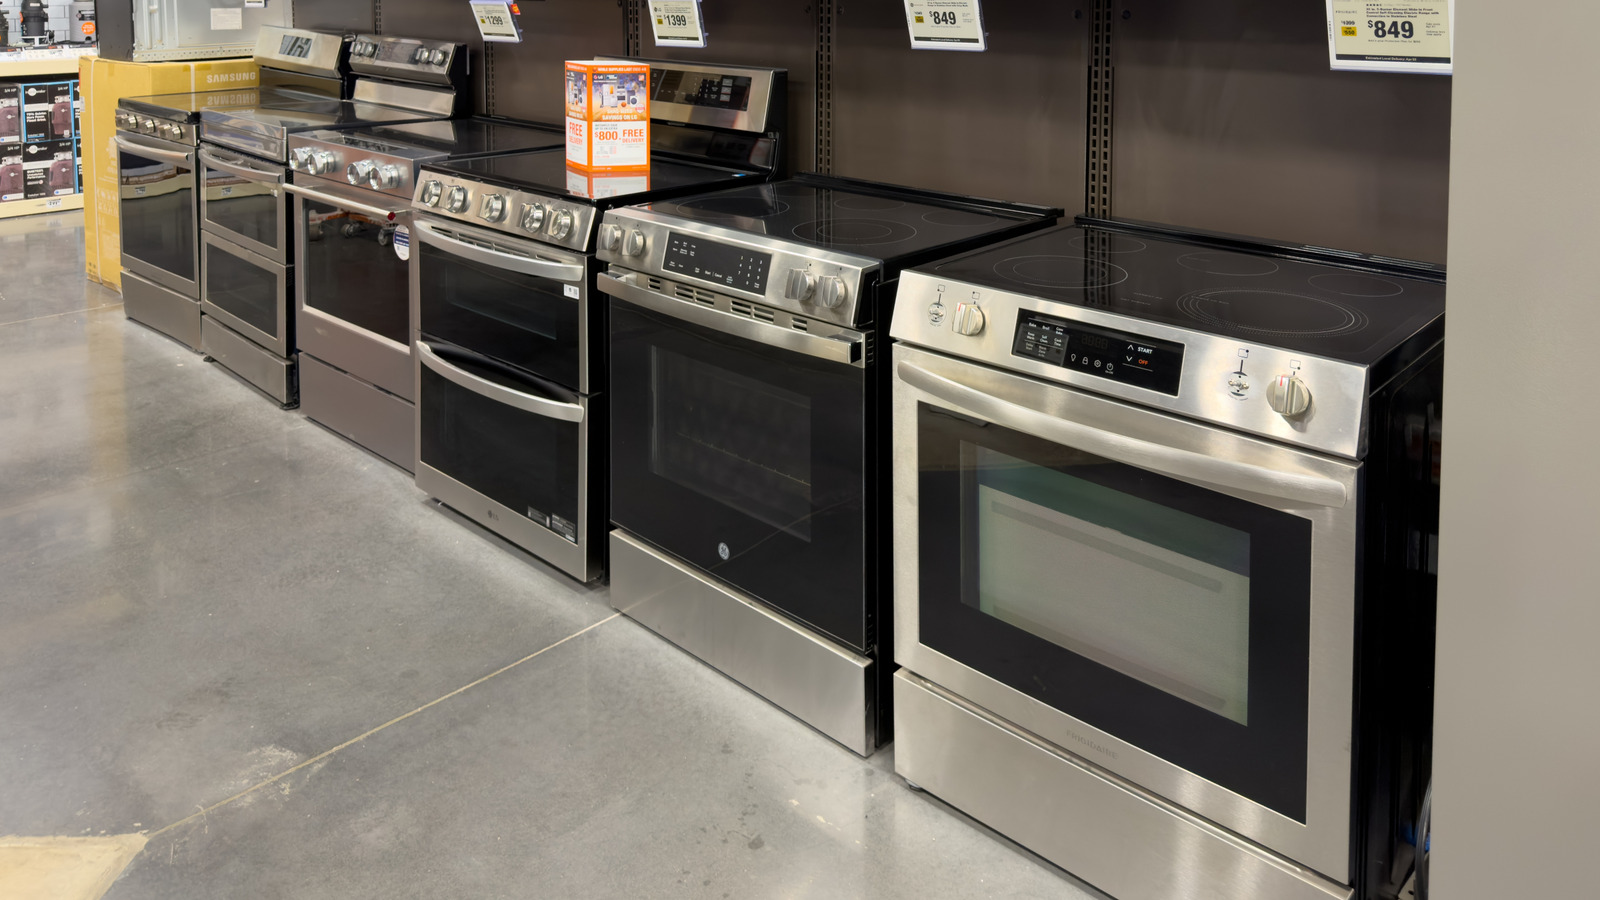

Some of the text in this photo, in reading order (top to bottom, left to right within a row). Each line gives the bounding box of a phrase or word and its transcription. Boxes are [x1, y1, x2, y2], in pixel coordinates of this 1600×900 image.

[664, 14, 686, 26] $1399
[929, 11, 956, 25] $849
[1368, 20, 1414, 38] $849
[207, 72, 256, 83] SAMSUNG
[569, 121, 582, 137] FREE
[622, 129, 644, 137] FREE
[1066, 729, 1118, 760] FRIGIDAIRE
